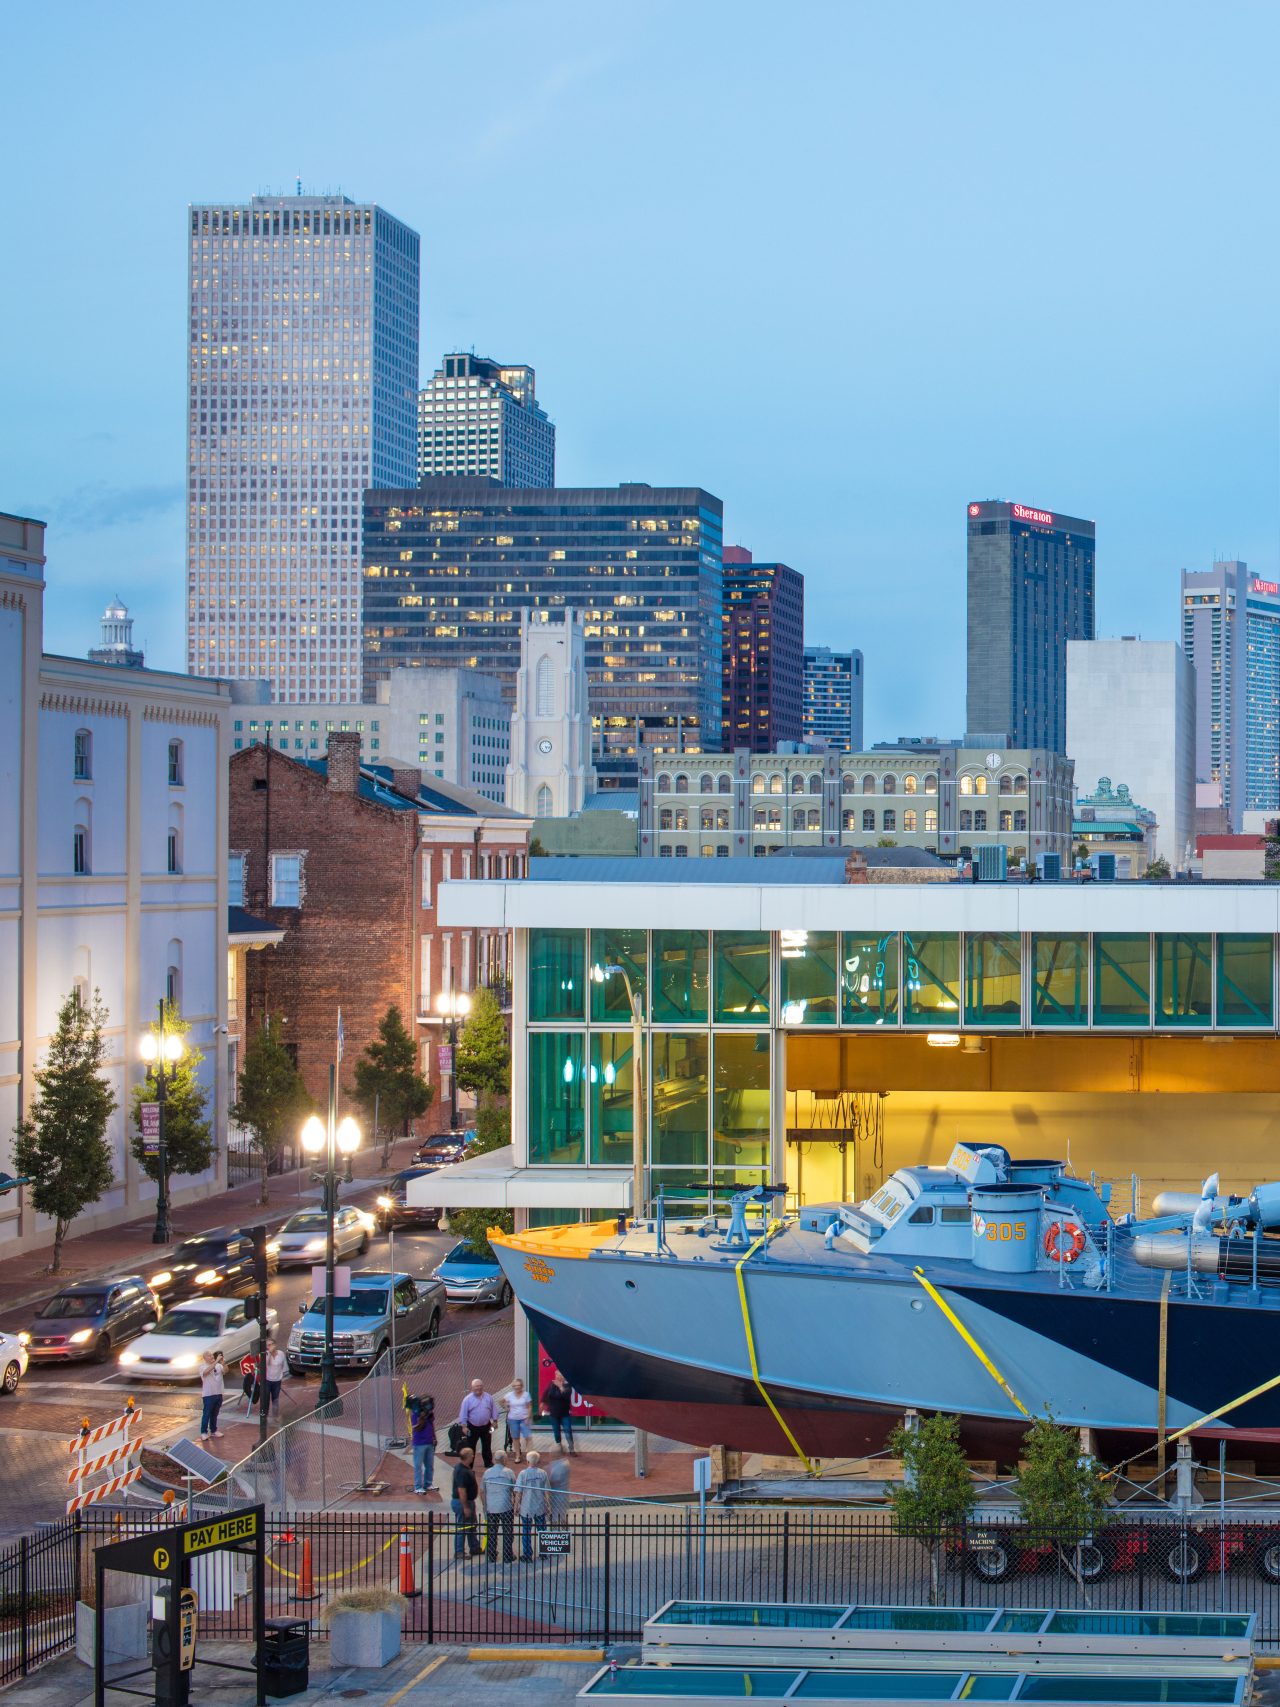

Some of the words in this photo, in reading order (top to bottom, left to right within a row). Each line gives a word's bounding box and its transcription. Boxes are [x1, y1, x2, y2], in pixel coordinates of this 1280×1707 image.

[1014, 504, 1052, 524] Sheraton
[1254, 579, 1278, 594] Marriott
[986, 1222, 1027, 1241] 305
[190, 1528, 217, 1548] PAY
[218, 1517, 253, 1540] HERE
[158, 1550, 167, 1568] P
